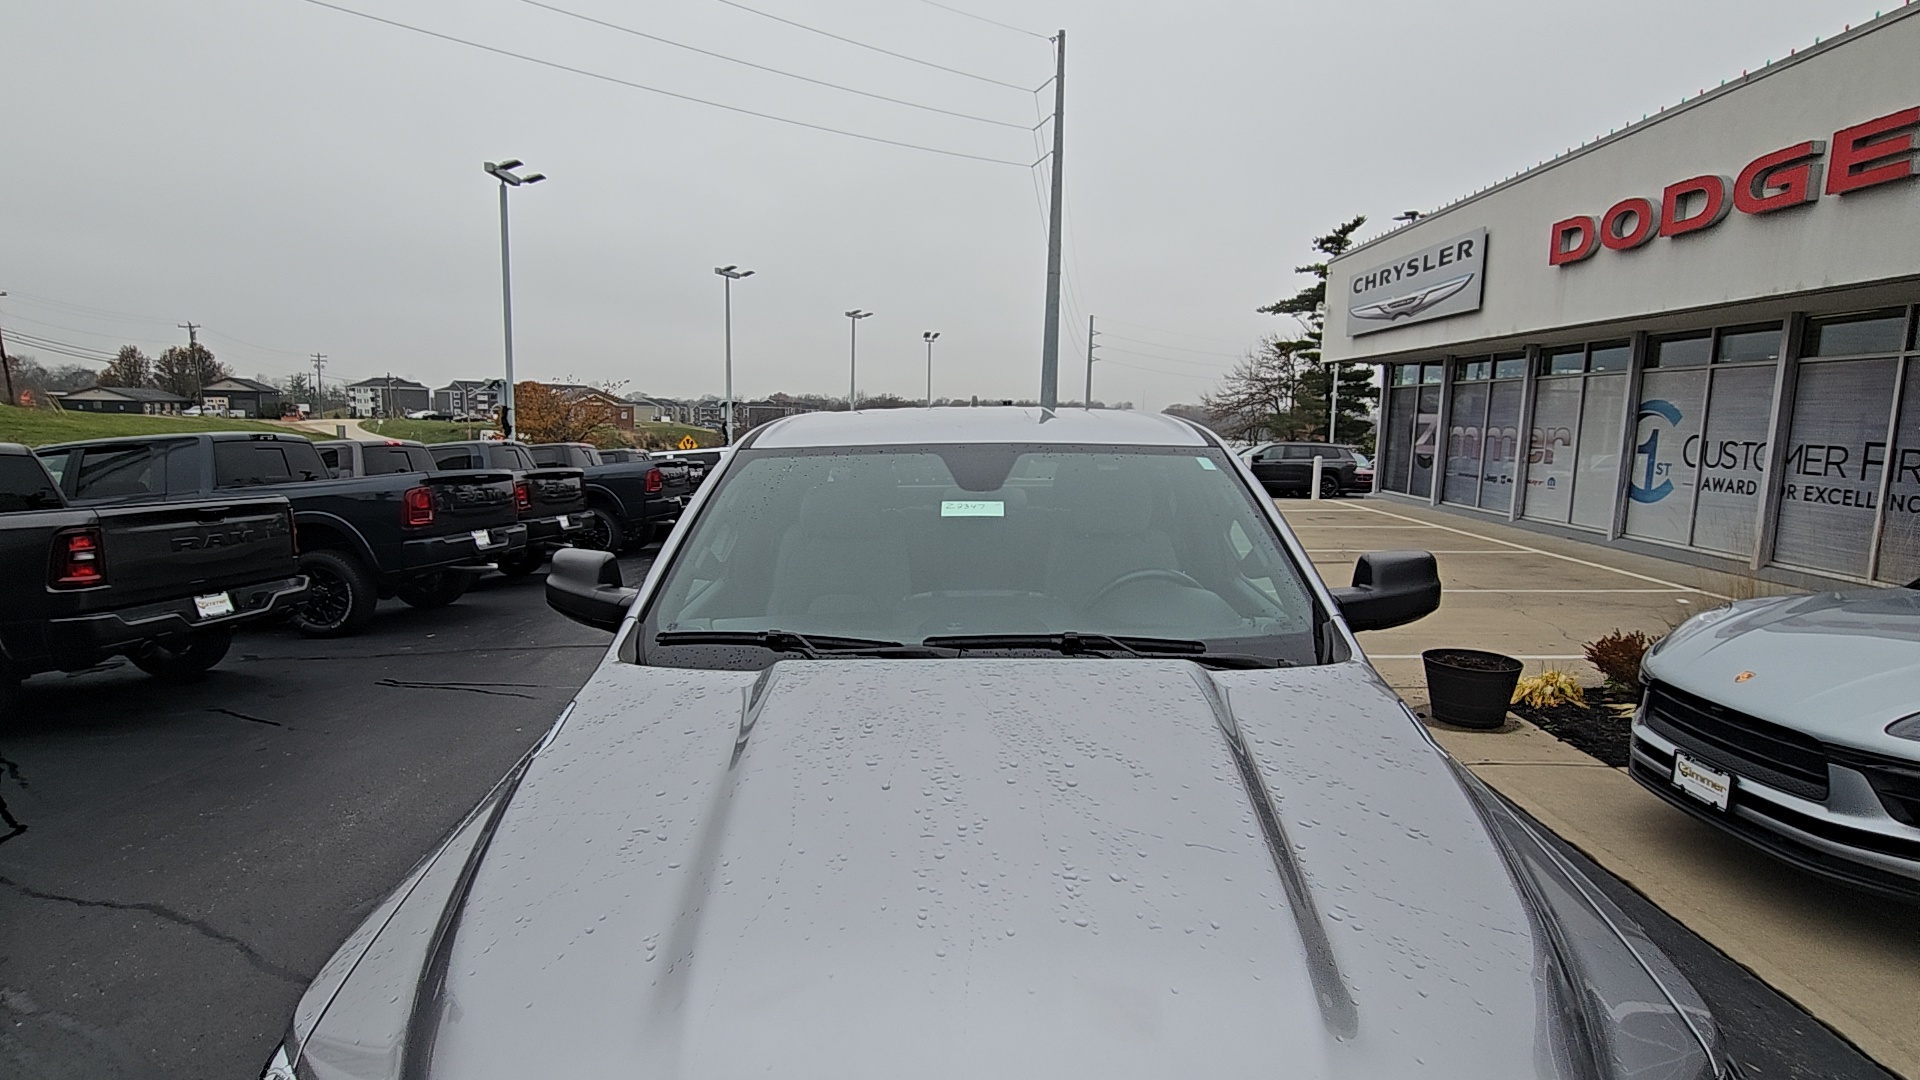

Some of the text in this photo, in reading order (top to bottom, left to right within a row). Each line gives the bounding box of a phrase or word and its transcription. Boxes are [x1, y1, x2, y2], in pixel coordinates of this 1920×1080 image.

[1549, 106, 1920, 266] DODGE
[1353, 240, 1474, 294] CHRYSLER
[1414, 412, 1571, 465] Zmmer
[1701, 477, 1757, 495] AWARD
[1803, 485, 1920, 513] EXCELLNC
[171, 530, 254, 552] RAM
[1679, 763, 1727, 793] Zimmer
